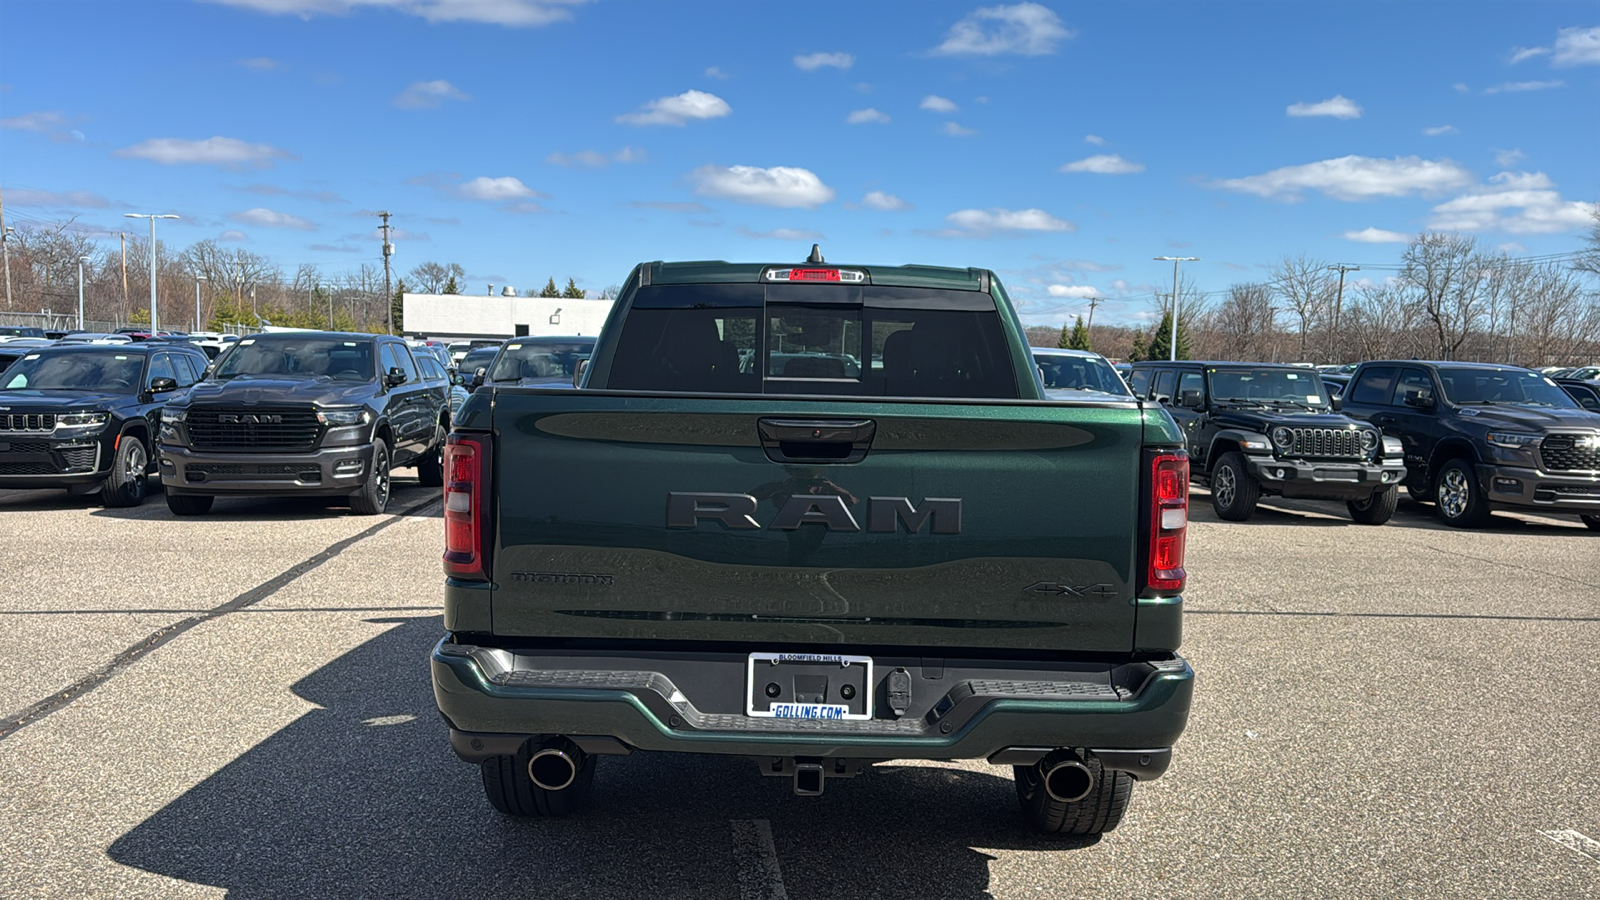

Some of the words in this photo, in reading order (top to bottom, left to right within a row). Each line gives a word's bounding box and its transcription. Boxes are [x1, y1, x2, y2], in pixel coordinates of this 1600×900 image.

[218, 414, 282, 424] RAM
[666, 491, 963, 534] RAM
[775, 704, 843, 720] GOLLING.COM
